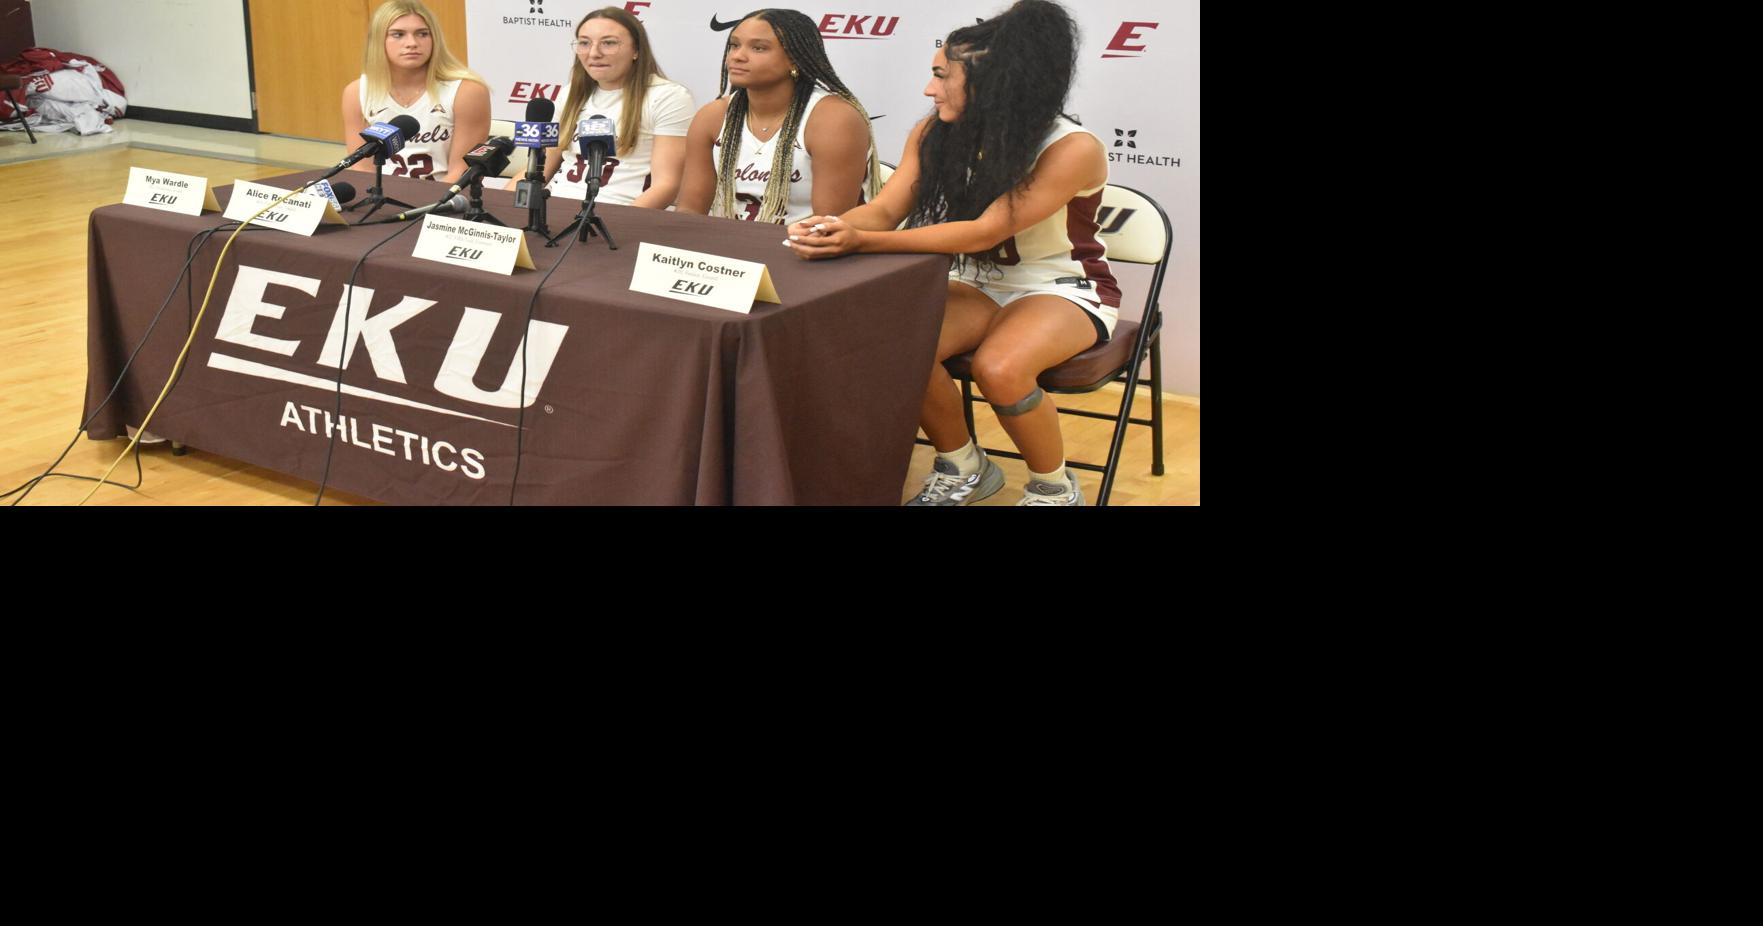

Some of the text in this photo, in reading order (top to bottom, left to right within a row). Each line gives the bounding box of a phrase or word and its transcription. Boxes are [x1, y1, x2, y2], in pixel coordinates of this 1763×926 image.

[503, 16, 572, 27] BAPTIST HEALTH
[818, 13, 900, 36] EKU
[1105, 21, 1160, 52] E
[1127, 154, 1181, 167] HEALTH
[145, 175, 189, 189] Mya Wardle
[734, 162, 802, 184] olons
[150, 193, 178, 205] EKU
[246, 188, 269, 200] Alice
[426, 221, 457, 233] Jasmine
[457, 226, 517, 244] McGinnis-Taylor
[447, 245, 484, 260] EKU
[652, 252, 695, 269] Kaitlyn
[697, 261, 746, 278] Costner
[671, 279, 715, 296] EKU
[214, 264, 570, 409] EKU
[279, 401, 486, 480] ATHLETICS
